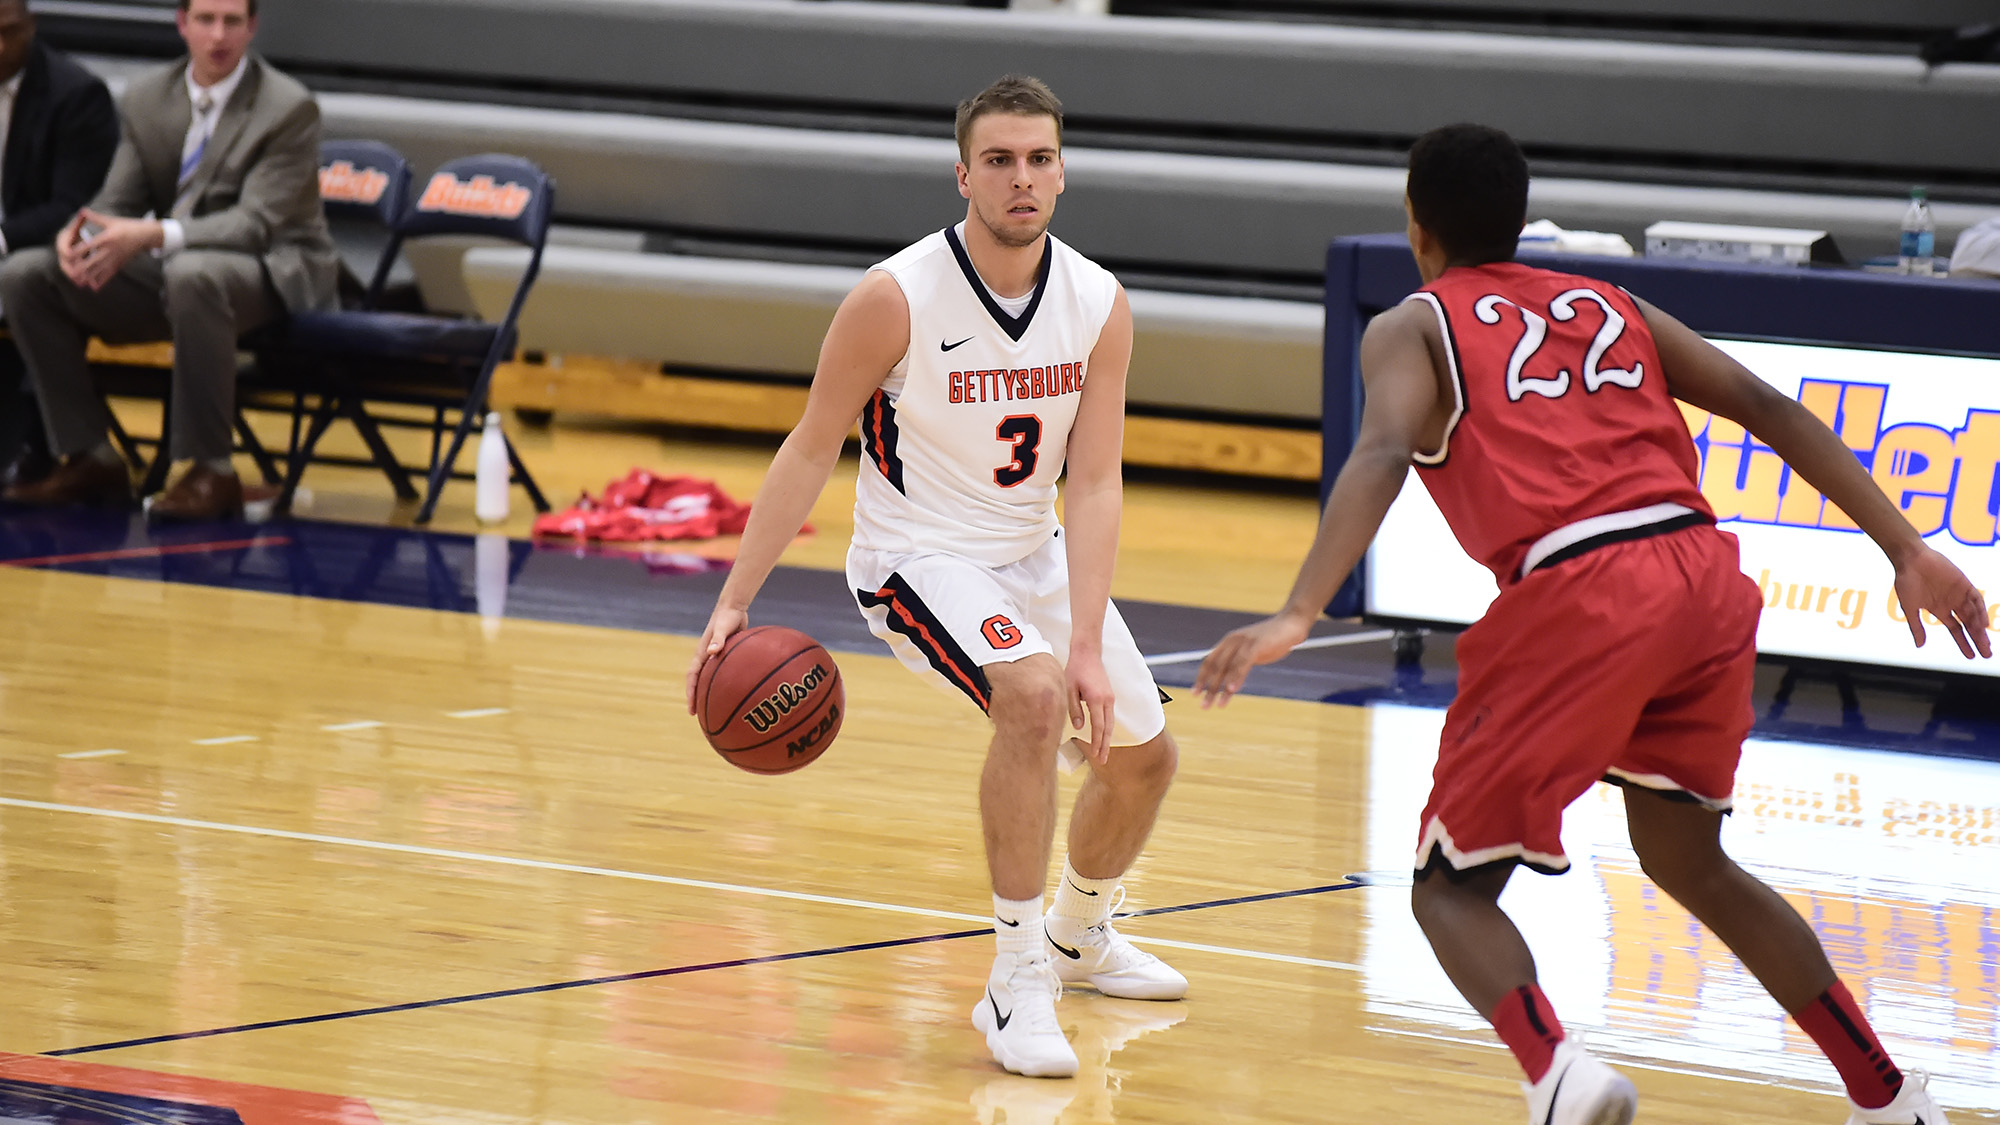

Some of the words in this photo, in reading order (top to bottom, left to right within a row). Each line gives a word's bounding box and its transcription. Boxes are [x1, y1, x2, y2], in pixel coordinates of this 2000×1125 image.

[318, 161, 388, 204] ullets
[417, 172, 531, 219] Bullets
[1475, 289, 1643, 402] 22
[993, 413, 1043, 488] 3
[1673, 377, 2000, 547] ullet
[980, 614, 1023, 650] G
[743, 663, 829, 734] Wilson
[786, 704, 840, 758] NCAA
